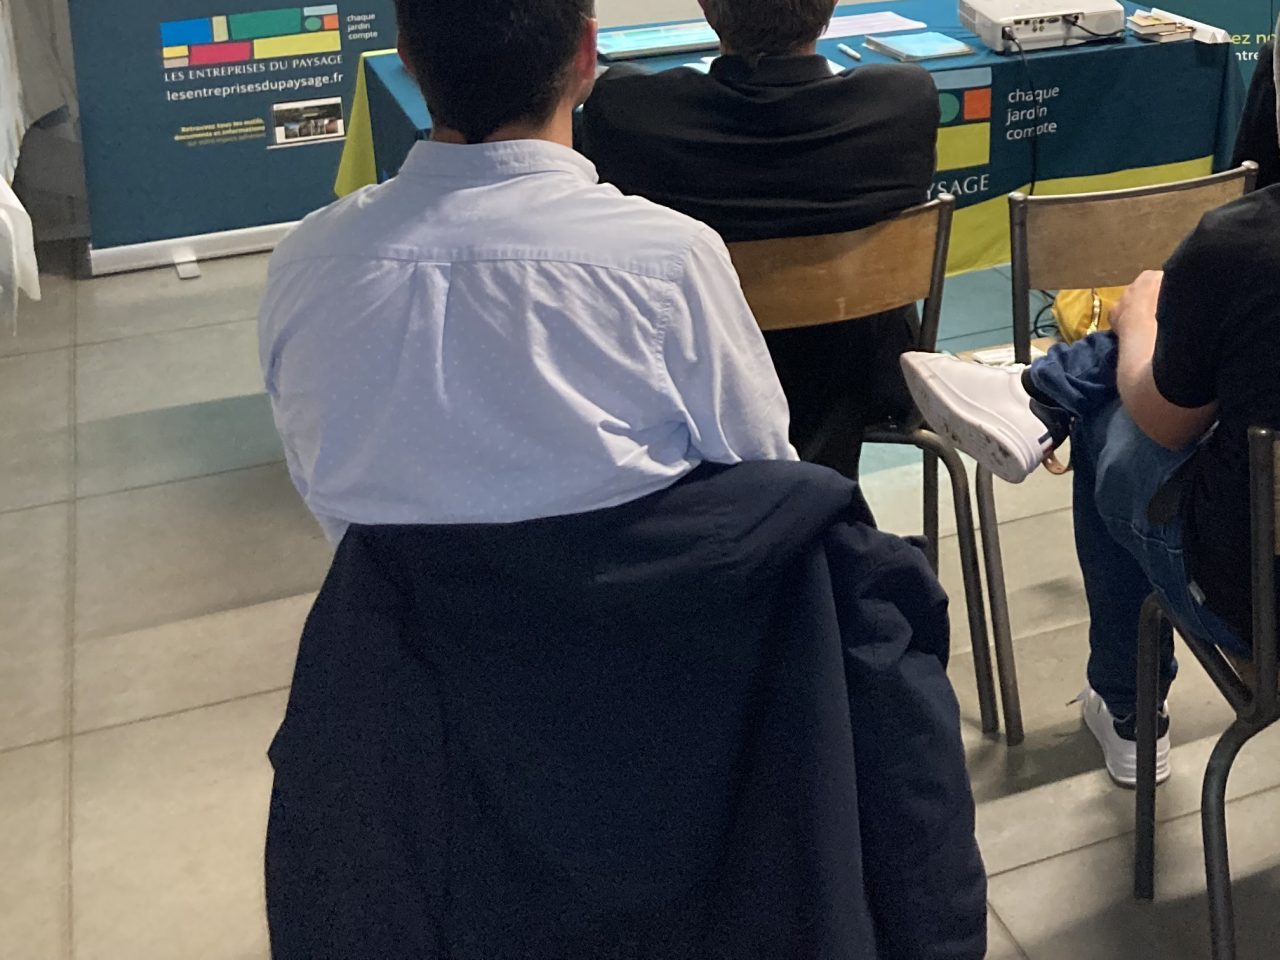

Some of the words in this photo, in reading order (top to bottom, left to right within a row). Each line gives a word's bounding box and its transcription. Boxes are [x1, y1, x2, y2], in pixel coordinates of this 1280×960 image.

[347, 13, 376, 22] chaque
[347, 23, 371, 32] jardin
[348, 31, 378, 40] compte
[164, 71, 185, 82] LES
[188, 62, 266, 80] ENTREPRISES
[270, 61, 289, 72] DU
[292, 54, 344, 68] PAYSAGE
[166, 72, 344, 102] lesentreprisesdupaysage.fr
[1008, 86, 1060, 103] chaque
[1005, 106, 1048, 126] jardin
[926, 173, 990, 200] YSAGE
